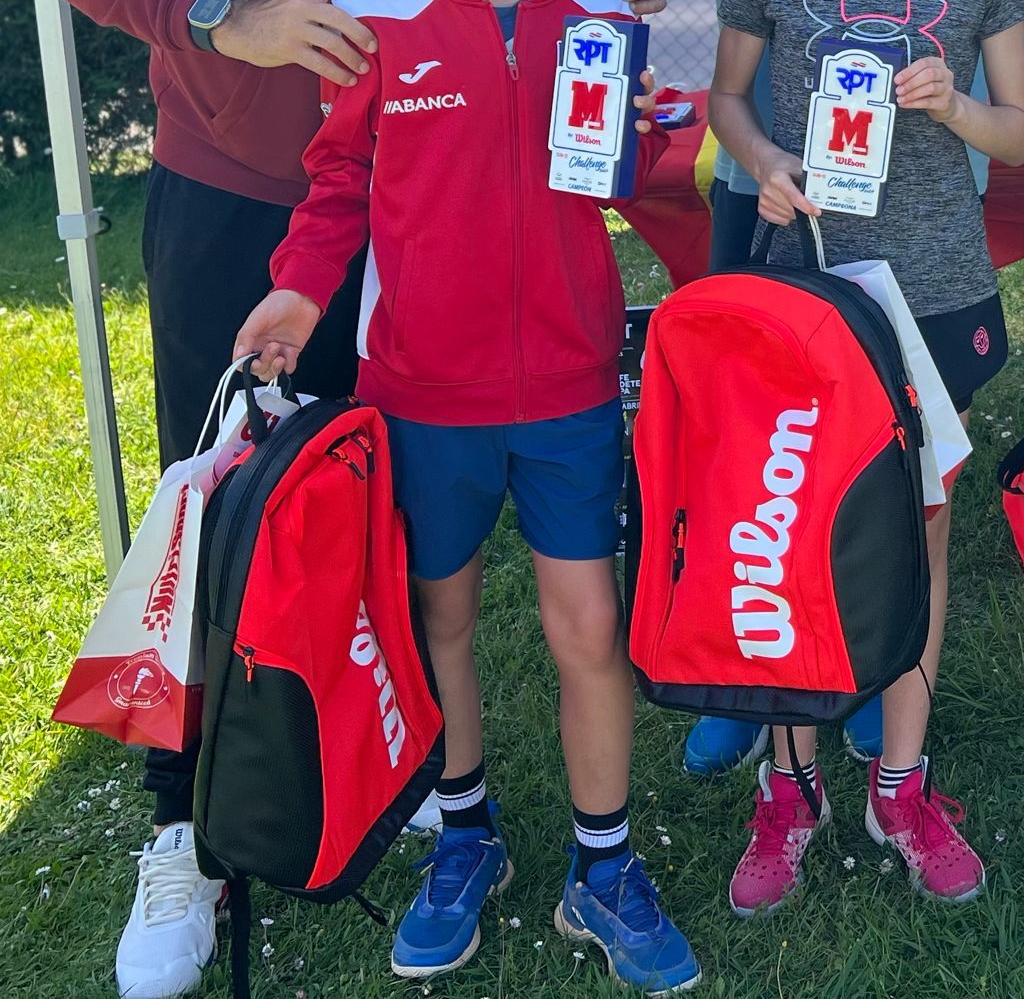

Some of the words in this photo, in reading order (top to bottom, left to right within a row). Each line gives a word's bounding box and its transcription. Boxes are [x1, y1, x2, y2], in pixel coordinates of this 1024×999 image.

[572, 38, 613, 66] RPT
[836, 67, 878, 95] RPT
[568, 80, 608, 130] M
[575, 133, 601, 145] Wilson
[828, 107, 873, 155] M
[568, 156, 607, 171] Challenge
[835, 156, 866, 168] Wilson
[828, 176, 872, 192] Challenge
[728, 406, 818, 660] Wilson
